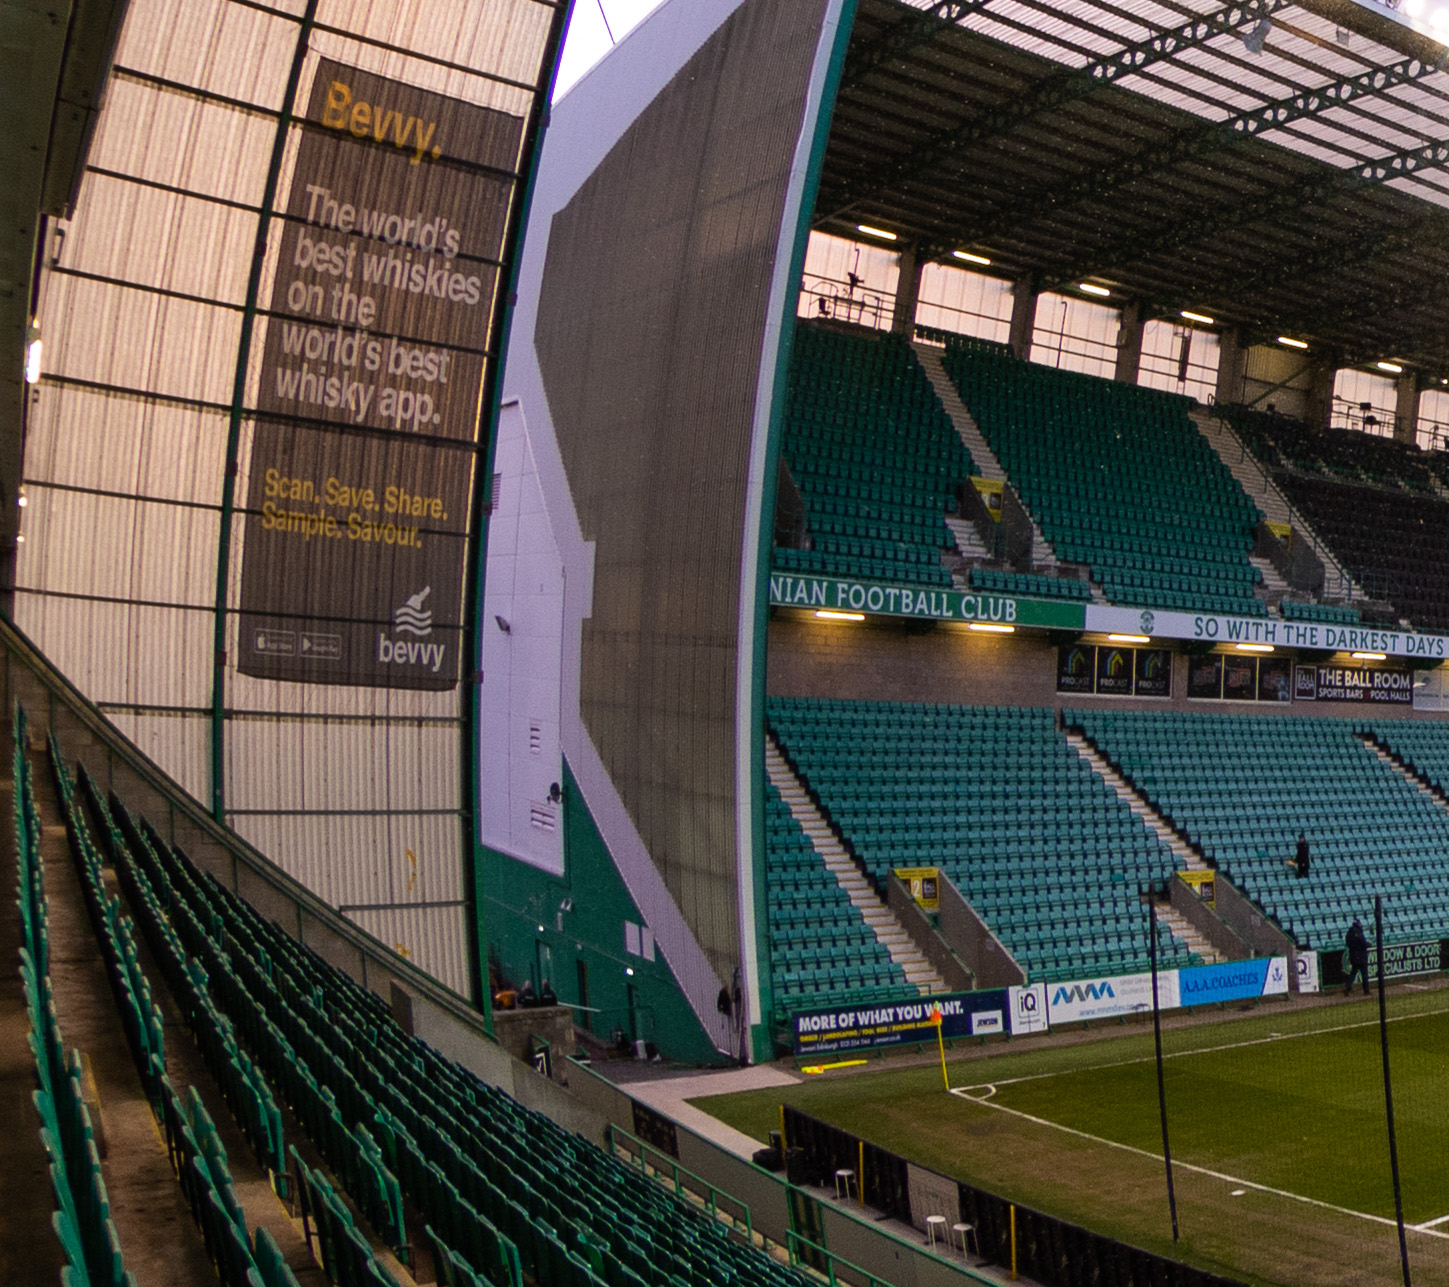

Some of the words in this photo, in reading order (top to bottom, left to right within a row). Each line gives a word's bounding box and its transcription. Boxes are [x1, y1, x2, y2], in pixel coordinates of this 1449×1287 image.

[322, 81, 442, 165] Bevvy.
[306, 184, 355, 232] The
[362, 209, 460, 258] world's
[294, 228, 356, 278] best
[363, 249, 481, 305] whiskies
[288, 280, 324, 316] on
[332, 282, 376, 326] the
[282, 323, 382, 371] world's
[388, 336, 450, 383] best
[276, 363, 375, 422] whisky
[379, 387, 441, 432] app.
[265, 469, 320, 503] Scan.
[325, 477, 379, 512] Save.
[385, 486, 448, 520] Share.
[262, 501, 342, 541] Sample.
[347, 513, 422, 548] Savour.
[836, 583, 953, 617] FOOTBALL
[961, 595, 1017, 622] CLUB
[378, 633, 445, 672] bevvy
[1195, 616, 1219, 637] SO
[1227, 620, 1276, 643] WITH
[1284, 624, 1318, 646] THE
[1326, 629, 1399, 652] DARKEST
[1406, 635, 1443, 656] DAYS
[1318, 667, 1342, 687] THE
[1345, 669, 1372, 688] BALL
[1374, 671, 1410, 689] ROOM
[1318, 687, 1344, 699] SPORTS
[1346, 689, 1363, 700] BARS
[1370, 690, 1389, 700] POOL
[1390, 691, 1410, 702] HALLS
[1367, 948, 1402, 962] WIDOW
[1405, 948, 1413, 958] &
[1414, 944, 1440, 957] DOOR
[1367, 958, 1424, 977] SPCIALISTS
[1425, 956, 1440, 970] LTD
[798, 1014, 836, 1032] MORE
[838, 1012, 855, 1029] OF
[856, 1008, 896, 1027] WHAT
[897, 1004, 923, 1022] YOU
[1021, 992, 1036, 1012] iQ
